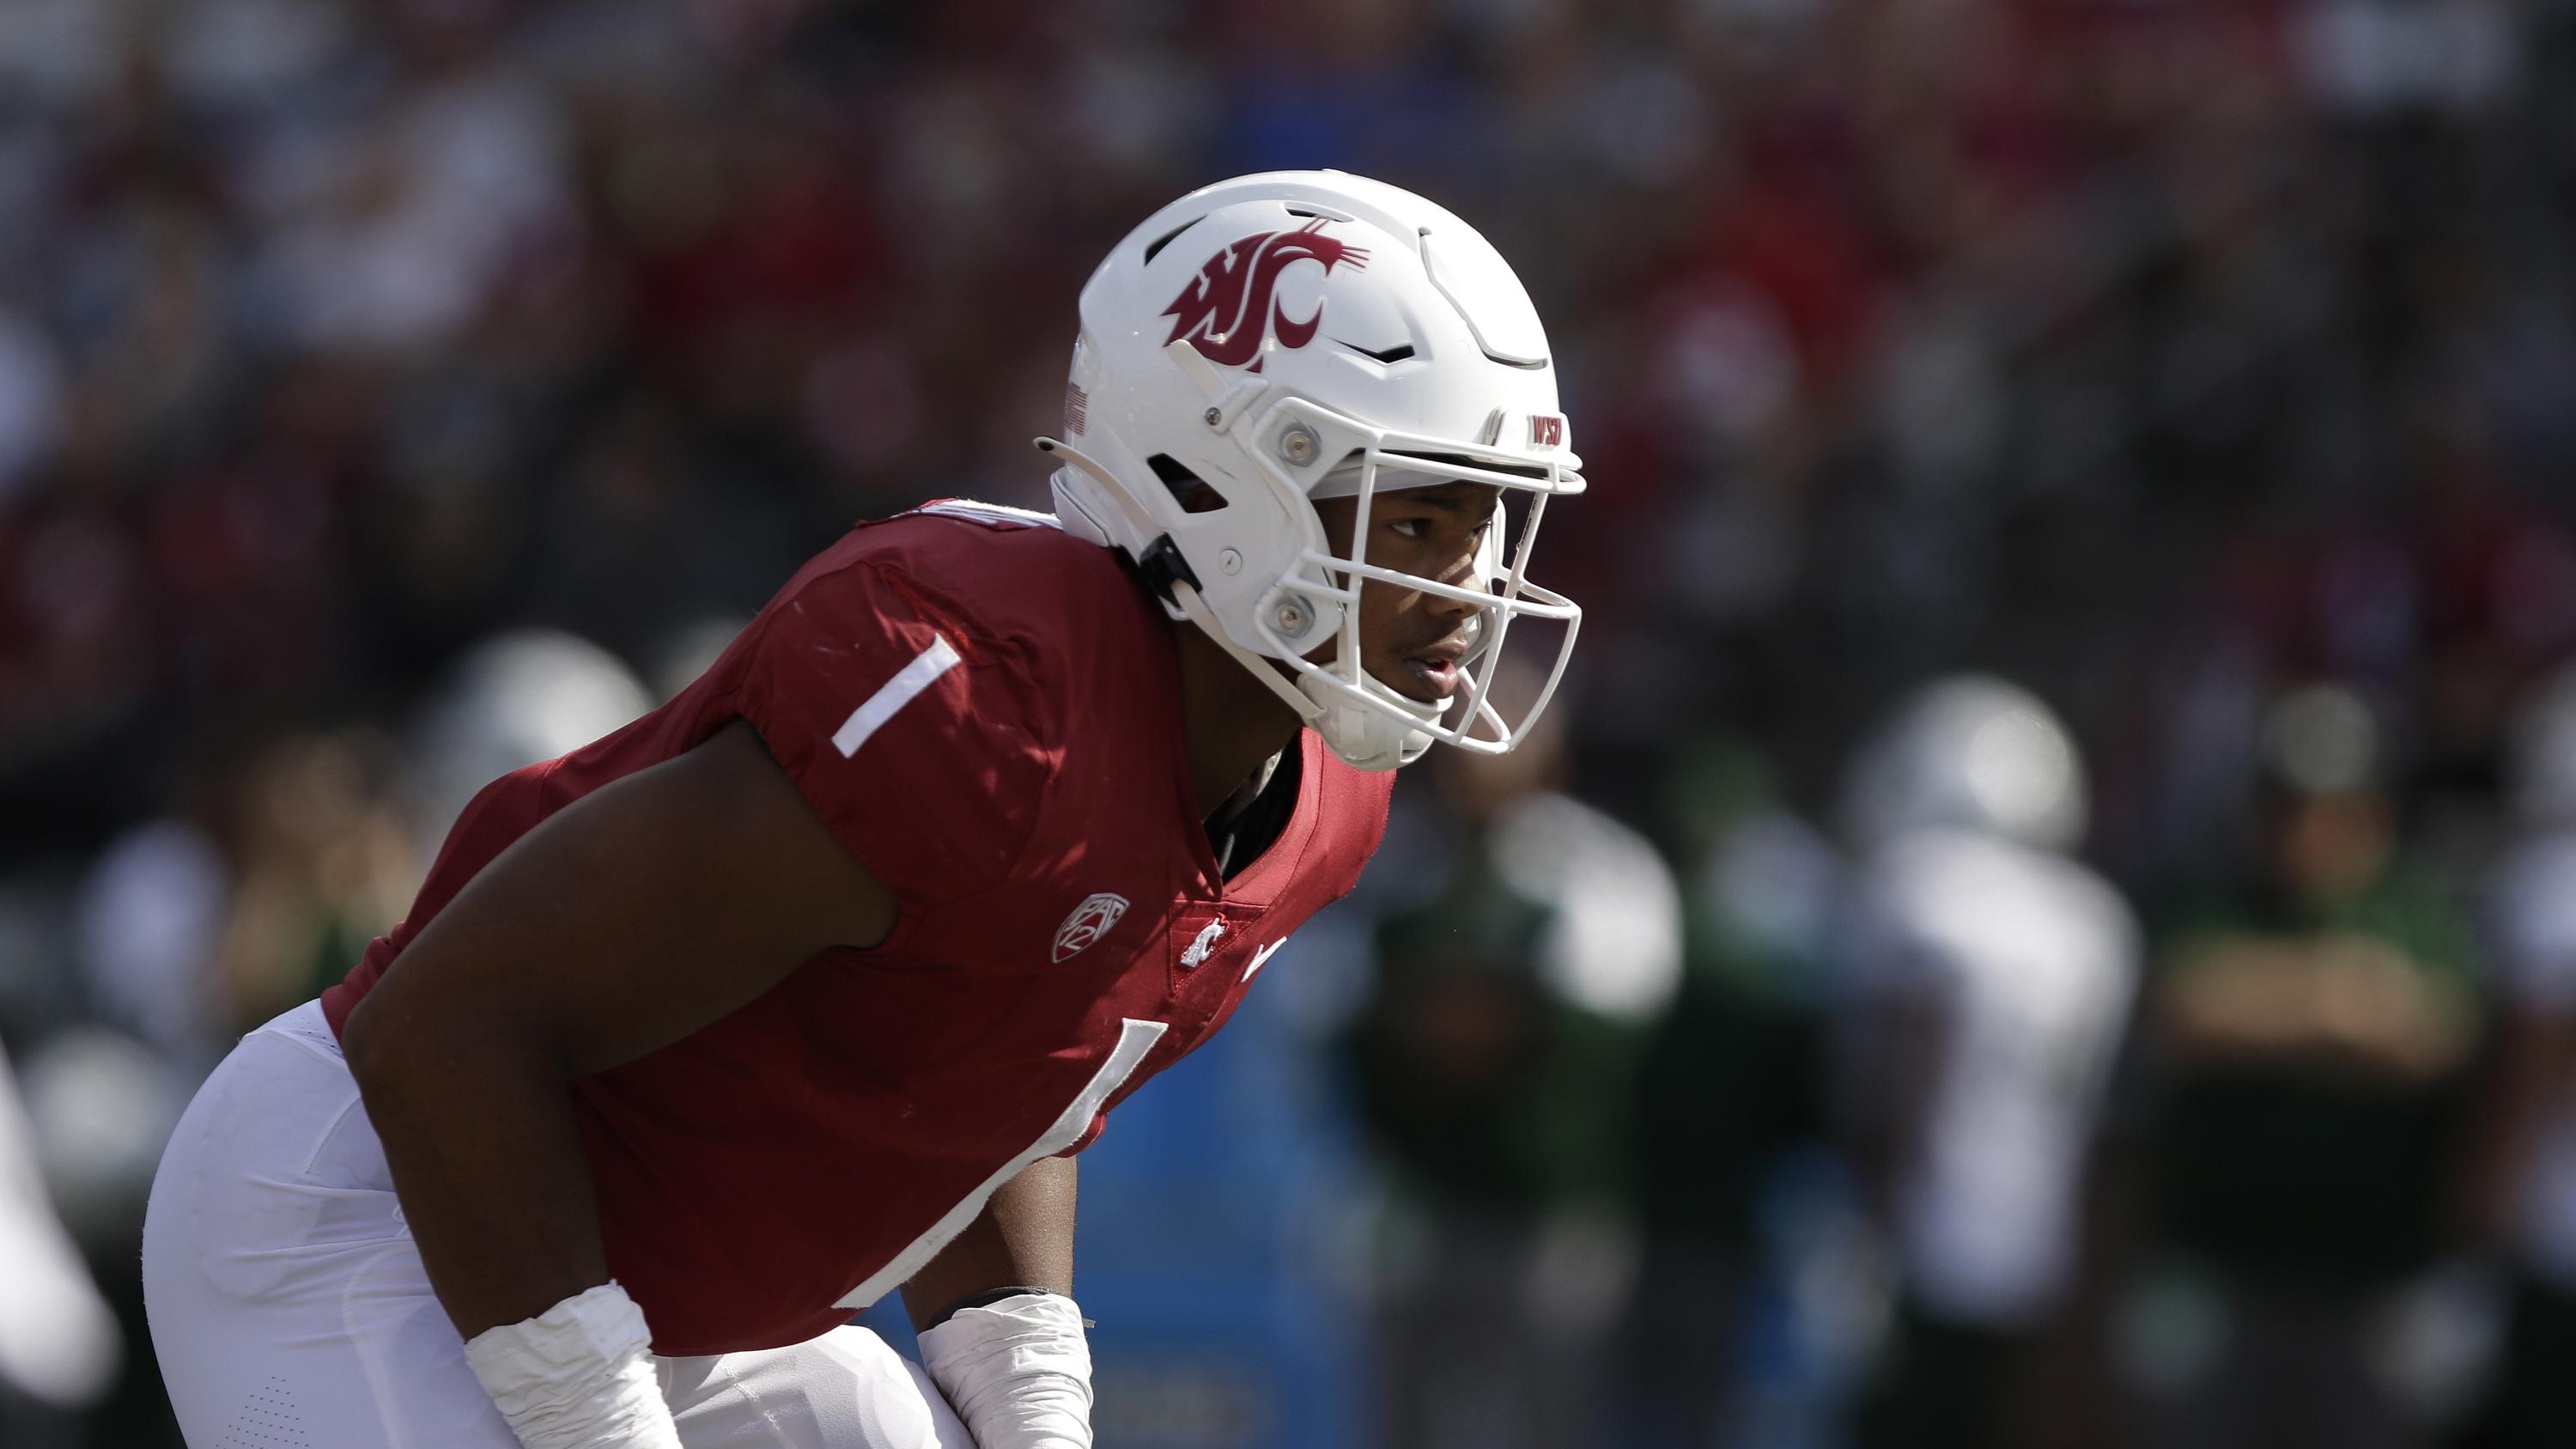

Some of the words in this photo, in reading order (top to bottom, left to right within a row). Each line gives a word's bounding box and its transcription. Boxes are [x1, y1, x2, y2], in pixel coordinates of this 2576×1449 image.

[831, 633, 961, 758] 1
[1060, 925, 1097, 950] 12
[1064, 897, 1125, 941] PAC
